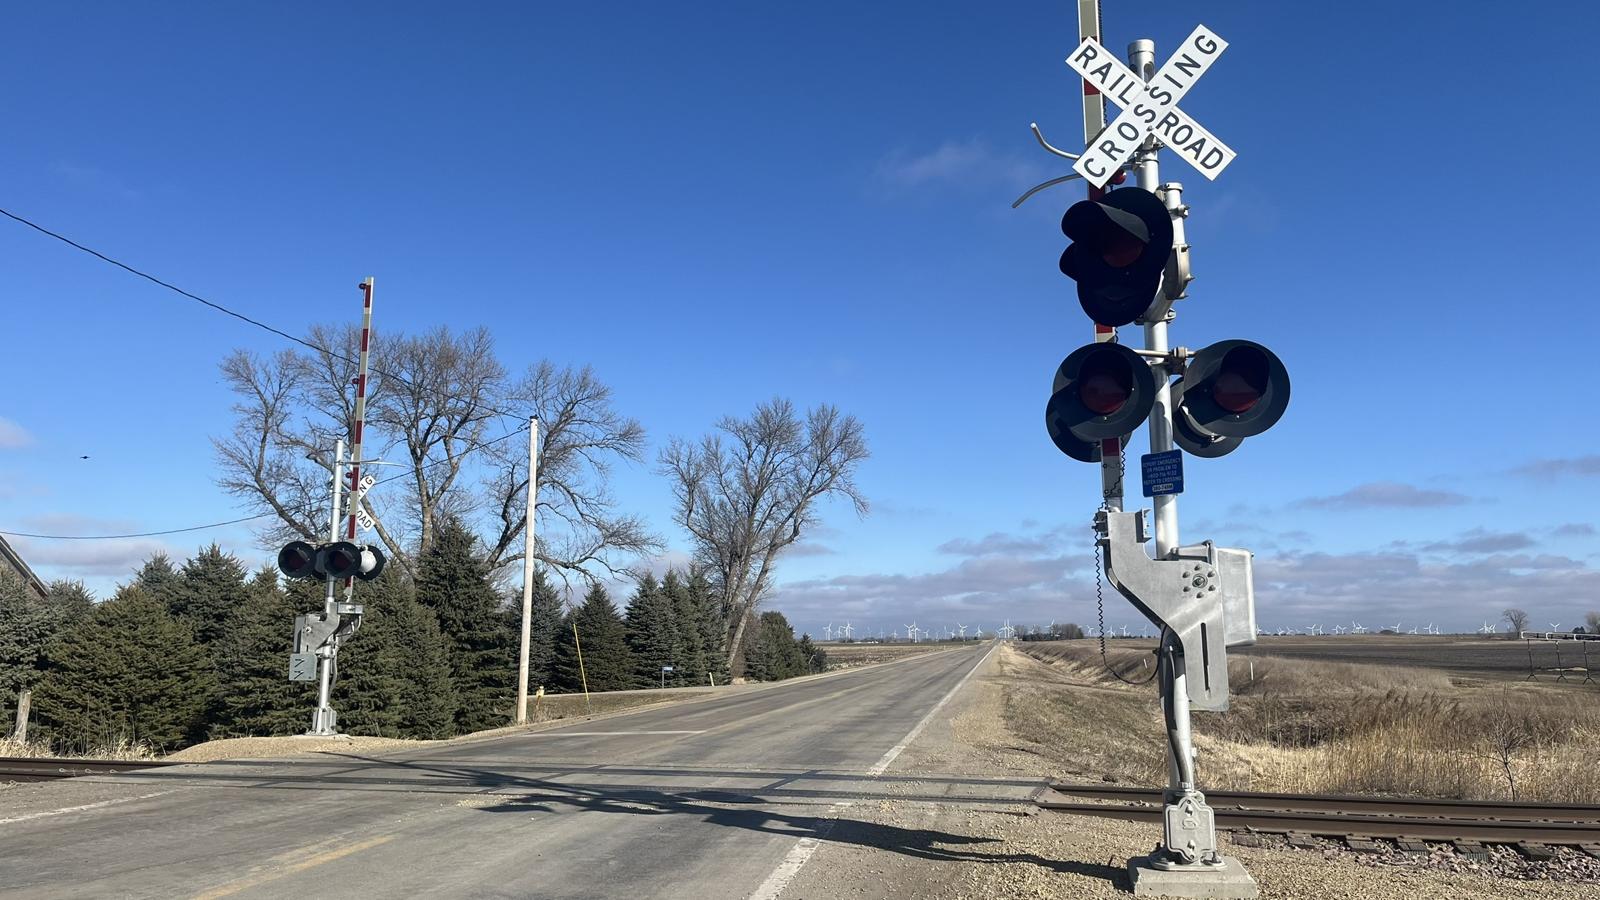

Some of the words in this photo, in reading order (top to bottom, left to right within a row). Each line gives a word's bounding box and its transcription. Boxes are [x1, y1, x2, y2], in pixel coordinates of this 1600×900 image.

[1074, 44, 1135, 106] RAIL
[1155, 111, 1224, 170] ROAD
[1083, 34, 1218, 178] CROSSING
